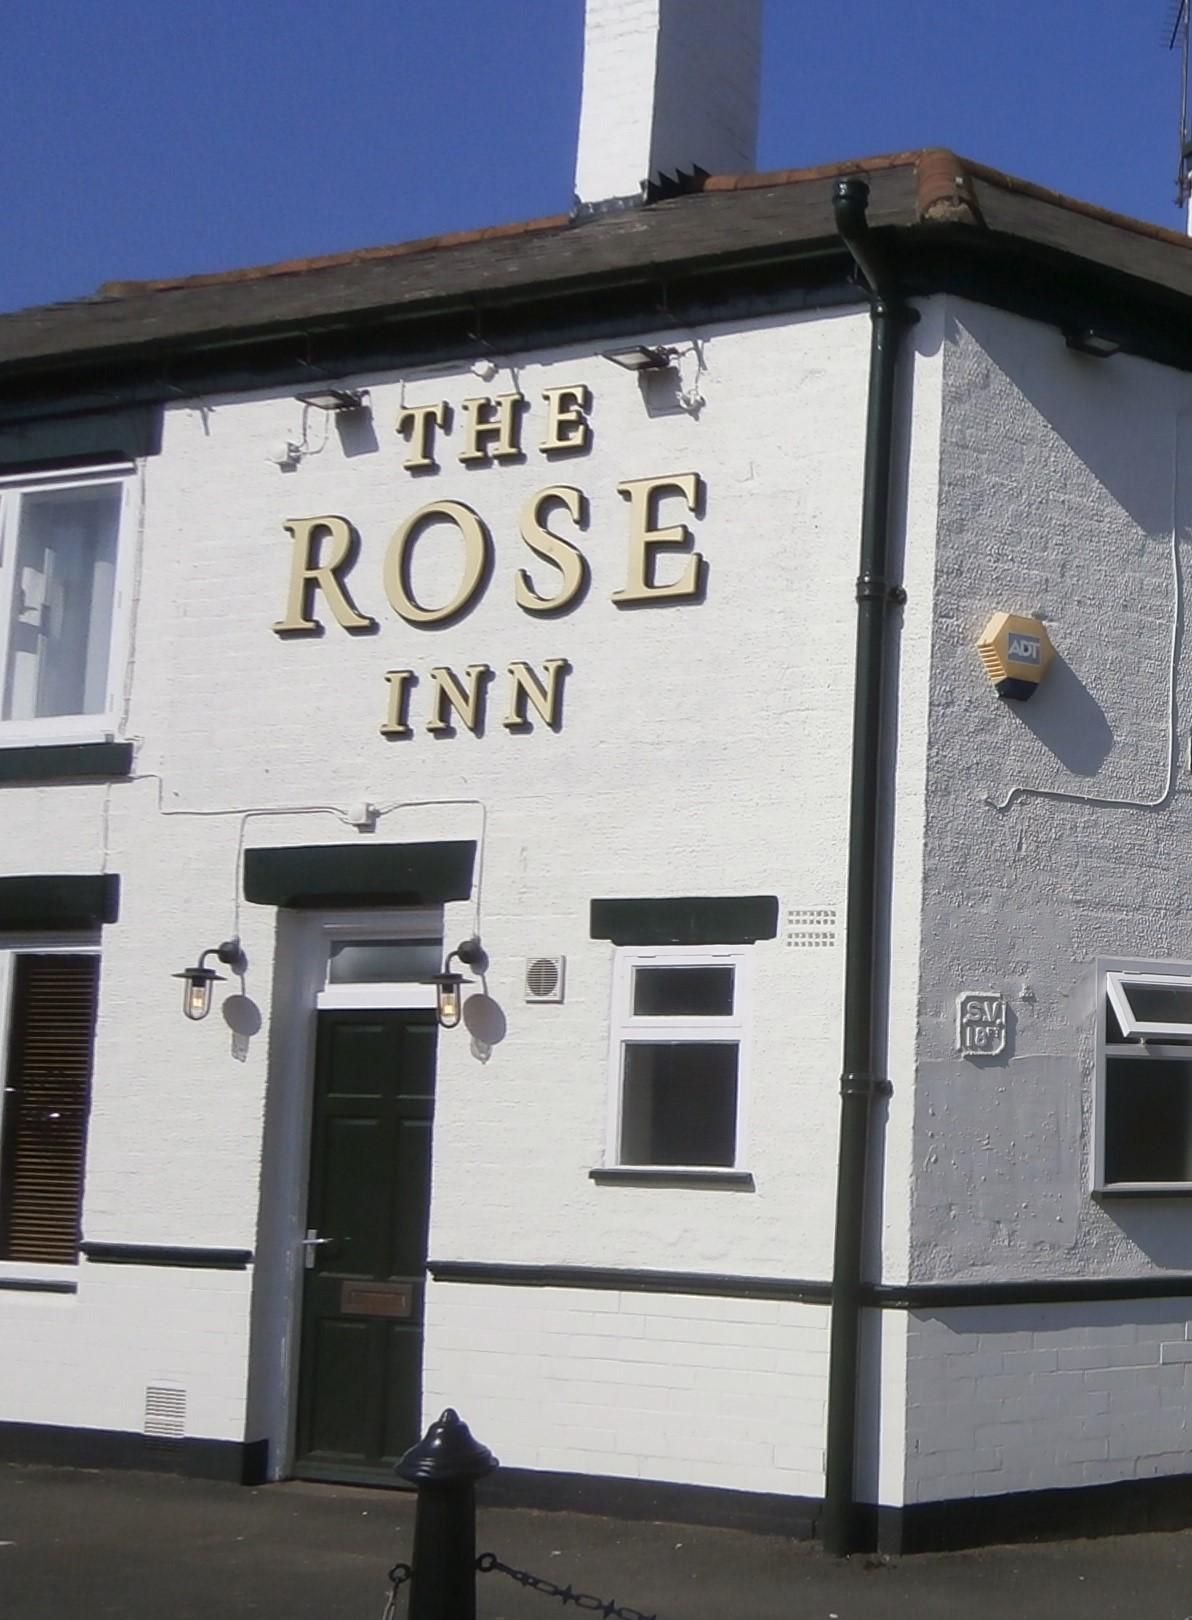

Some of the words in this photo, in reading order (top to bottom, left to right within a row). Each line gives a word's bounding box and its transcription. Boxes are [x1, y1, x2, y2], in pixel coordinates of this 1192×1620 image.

[398, 384, 591, 469] THE
[273, 472, 703, 634] ROSE
[1009, 639, 1040, 659] ADT
[379, 658, 569, 737] INN
